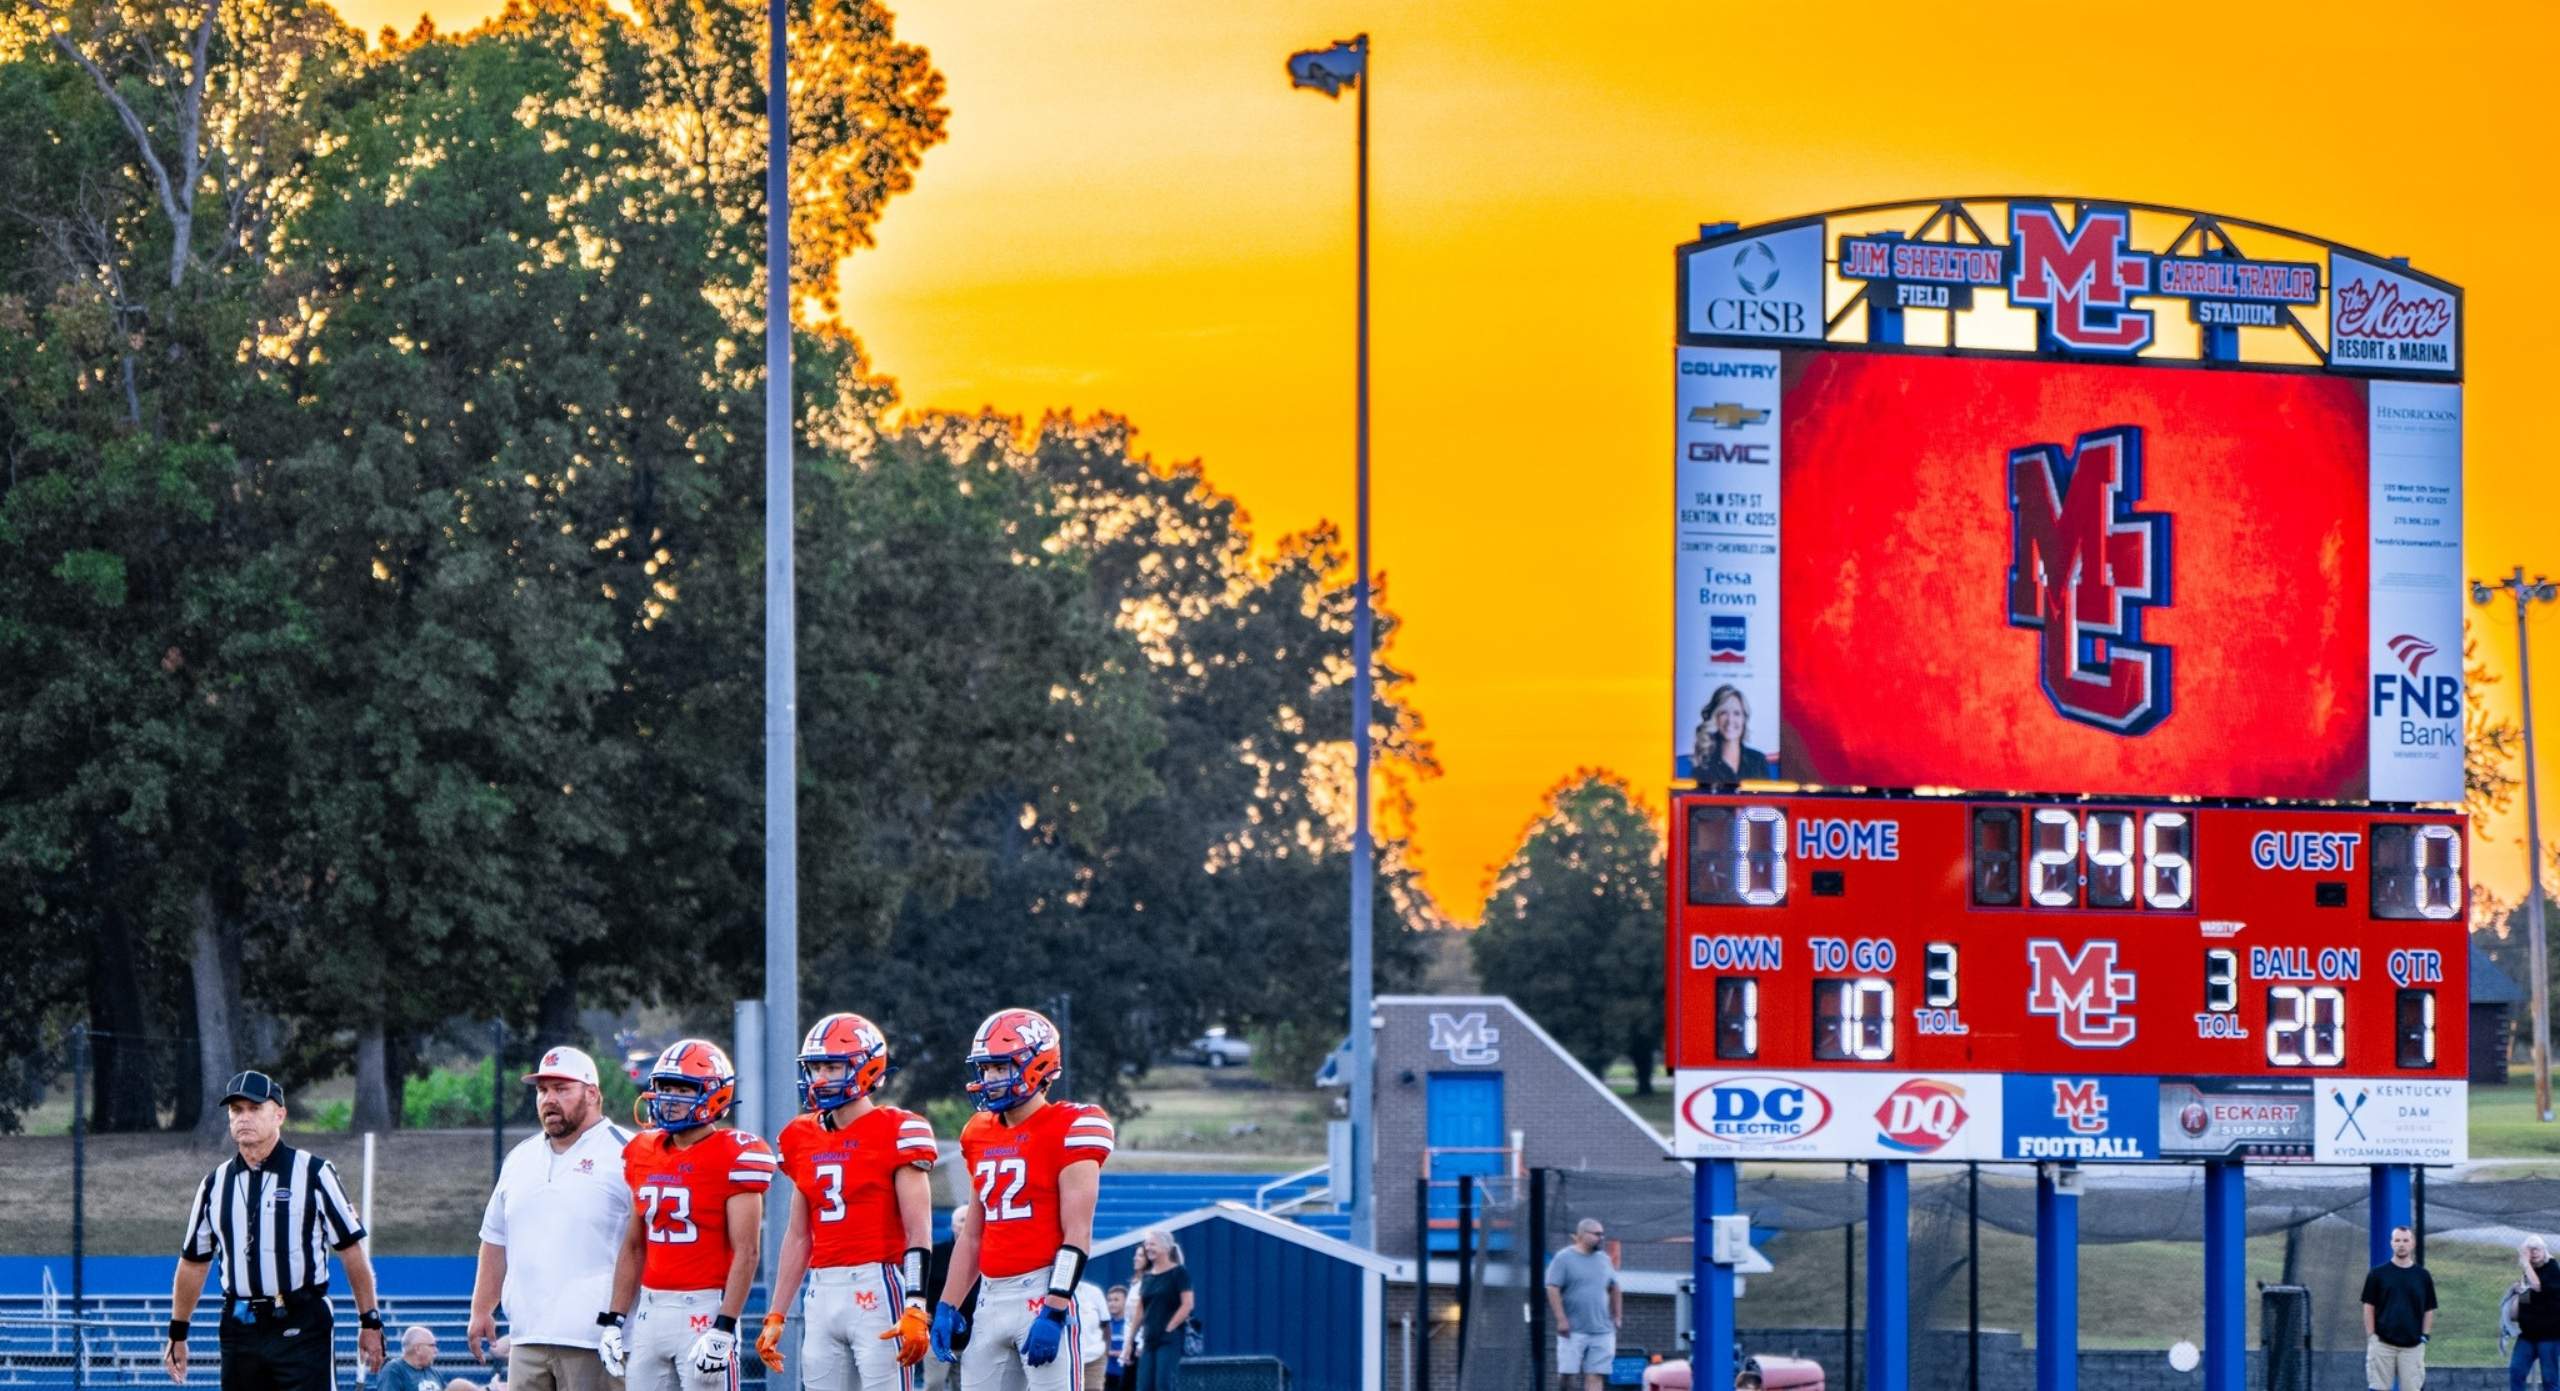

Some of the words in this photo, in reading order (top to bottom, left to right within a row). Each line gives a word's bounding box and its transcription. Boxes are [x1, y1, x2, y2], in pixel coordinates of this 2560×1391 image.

[1843, 240, 1890, 278] JIM
[1893, 244, 2002, 285] SHELTON
[1897, 284, 1950, 307] FIELD
[2160, 260, 2238, 297] CARROLL
[2237, 264, 2316, 302] TRAYLOR
[1707, 297, 1806, 334] CFSB
[2200, 302, 2276, 325] STADIUM
[2337, 338, 2385, 359] RESORT
[2387, 344, 2396, 360] &
[2399, 341, 2449, 363] MARINA
[1681, 361, 1777, 379] COUNTRY
[1689, 442, 1770, 465] GMC
[1750, 493, 1762, 508] ST
[1704, 566, 1752, 585] Tessa
[1699, 587, 1757, 605] Brown
[2374, 674, 2460, 719] FNB
[2401, 721, 2457, 746] Bank
[1736, 806, 1788, 905] 0
[1797, 818, 1899, 860] HOME
[2251, 830, 2361, 872] GUEST
[2414, 824, 2463, 919] 0
[1692, 936, 1782, 971] DOWN
[1808, 937, 1849, 971] TO
[1854, 937, 1897, 972] GO
[2251, 947, 2314, 979] BALL
[2317, 948, 2361, 980] ON
[2388, 950, 2442, 986] QTR
[1927, 943, 1958, 1007] 3
[2208, 949, 2238, 1012] 3
[1744, 980, 1758, 1055] 1
[1840, 977, 1894, 1060] 10
[1914, 1009, 1970, 1035] T.O.L.
[2195, 1013, 2249, 1039] T.O.L.
[2266, 986, 2345, 1067] 20
[2423, 992, 2436, 1064] 1
[1712, 1087, 1804, 1122] DC
[2376, 1085, 2452, 1097] KENTUCKY
[1713, 1123, 1801, 1135] ELECTRIC
[1888, 1094, 1957, 1141] DQ
[2213, 1104, 2299, 1121] ECKART
[2399, 1106, 2430, 1118] DAM
[2018, 1136, 2143, 1158] FOOTBALL
[2221, 1126, 2291, 1136] SUPPLY
[2334, 1147, 2451, 1158] KYDAMMARINA.COM
[816, 1164, 847, 1222] 3
[975, 1158, 1033, 1222] 22
[639, 1186, 699, 1243] 23
